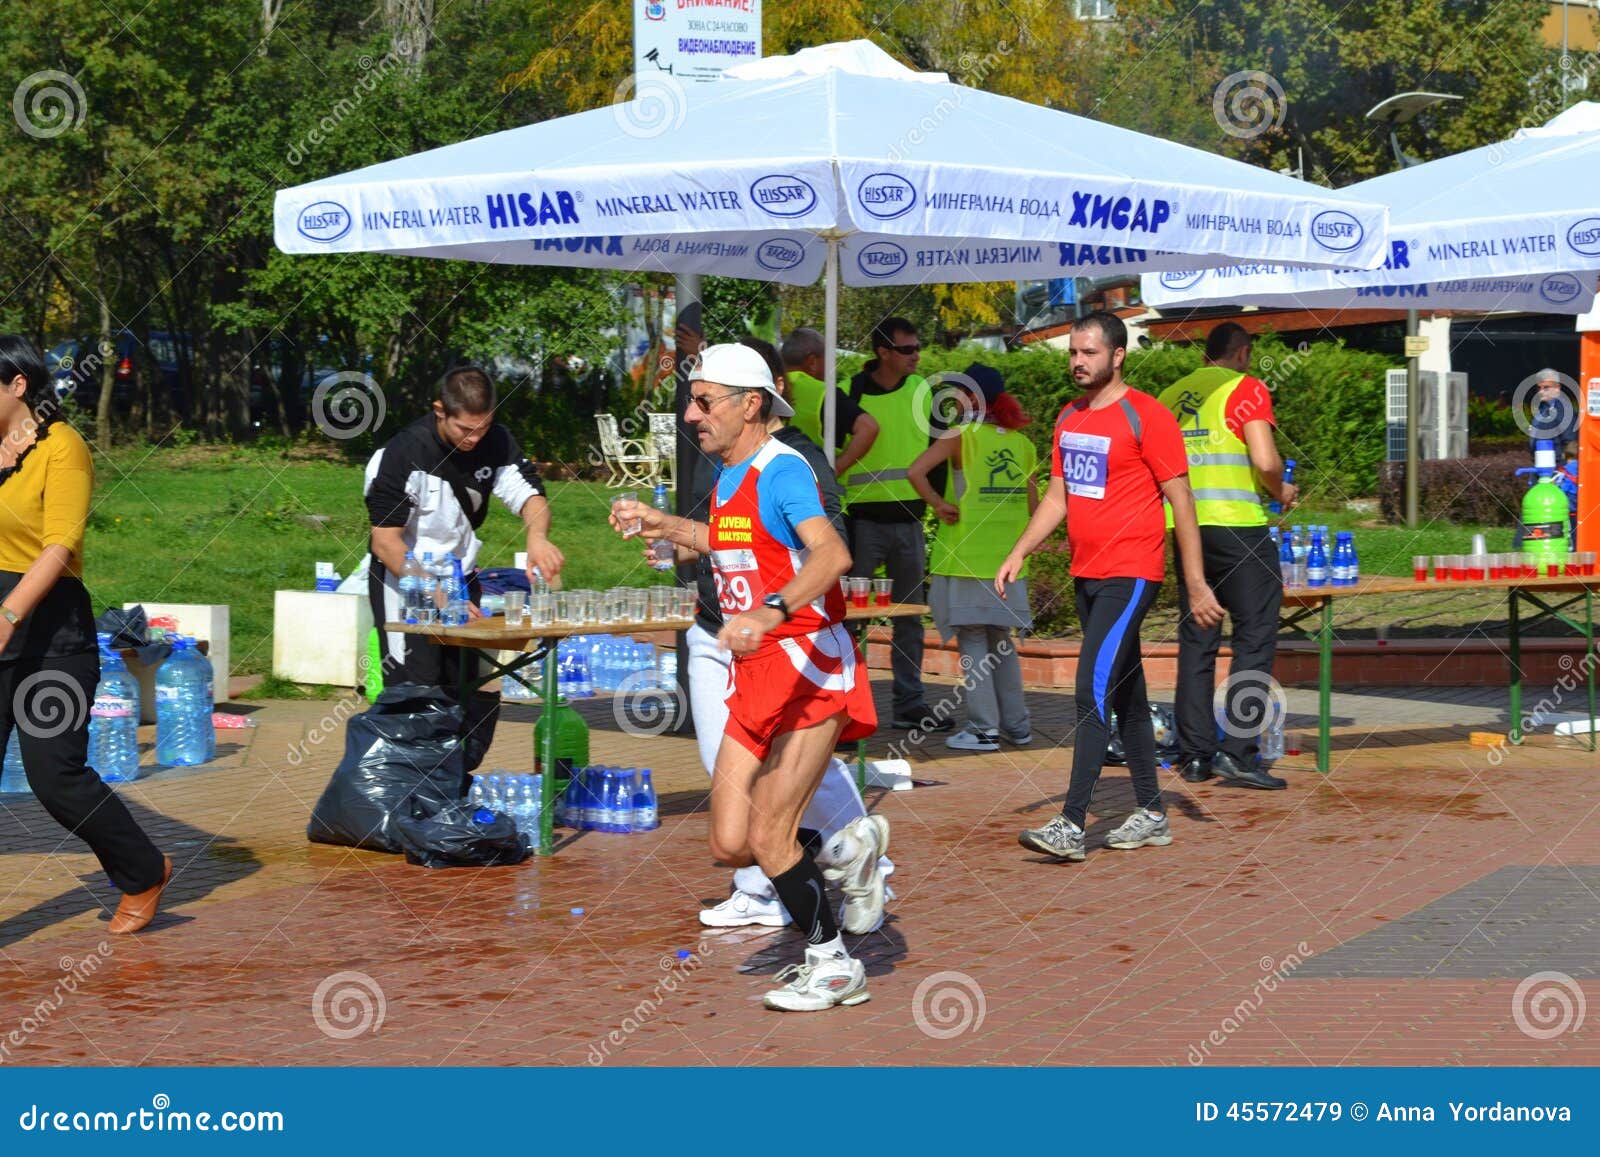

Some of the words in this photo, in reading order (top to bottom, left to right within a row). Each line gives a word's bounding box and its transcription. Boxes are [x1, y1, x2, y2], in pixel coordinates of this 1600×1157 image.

[678, 38, 756, 57] ВИДЕОНАБЛЮДЕНИЕ
[758, 185, 806, 204] HISSAR
[864, 185, 905, 204] HISSAR
[303, 211, 343, 229] HISSAR
[362, 207, 425, 231] MINERAL
[430, 206, 483, 226] WATER
[596, 193, 677, 217] MINERAL
[678, 190, 743, 211] WATER
[925, 191, 1014, 215] МИНЕРАЛНА
[1019, 198, 1061, 218] ВОДА
[1186, 213, 1262, 235] МИНЕРАЛНА
[1267, 219, 1303, 238] ВОДА
[1317, 222, 1358, 239] HISSAR
[1574, 228, 1600, 245] HISSA
[1427, 238, 1498, 262] MINERAL
[1502, 234, 1556, 255] WATER
[1063, 452, 1099, 482] 466
[718, 516, 751, 529] JUVENIA
